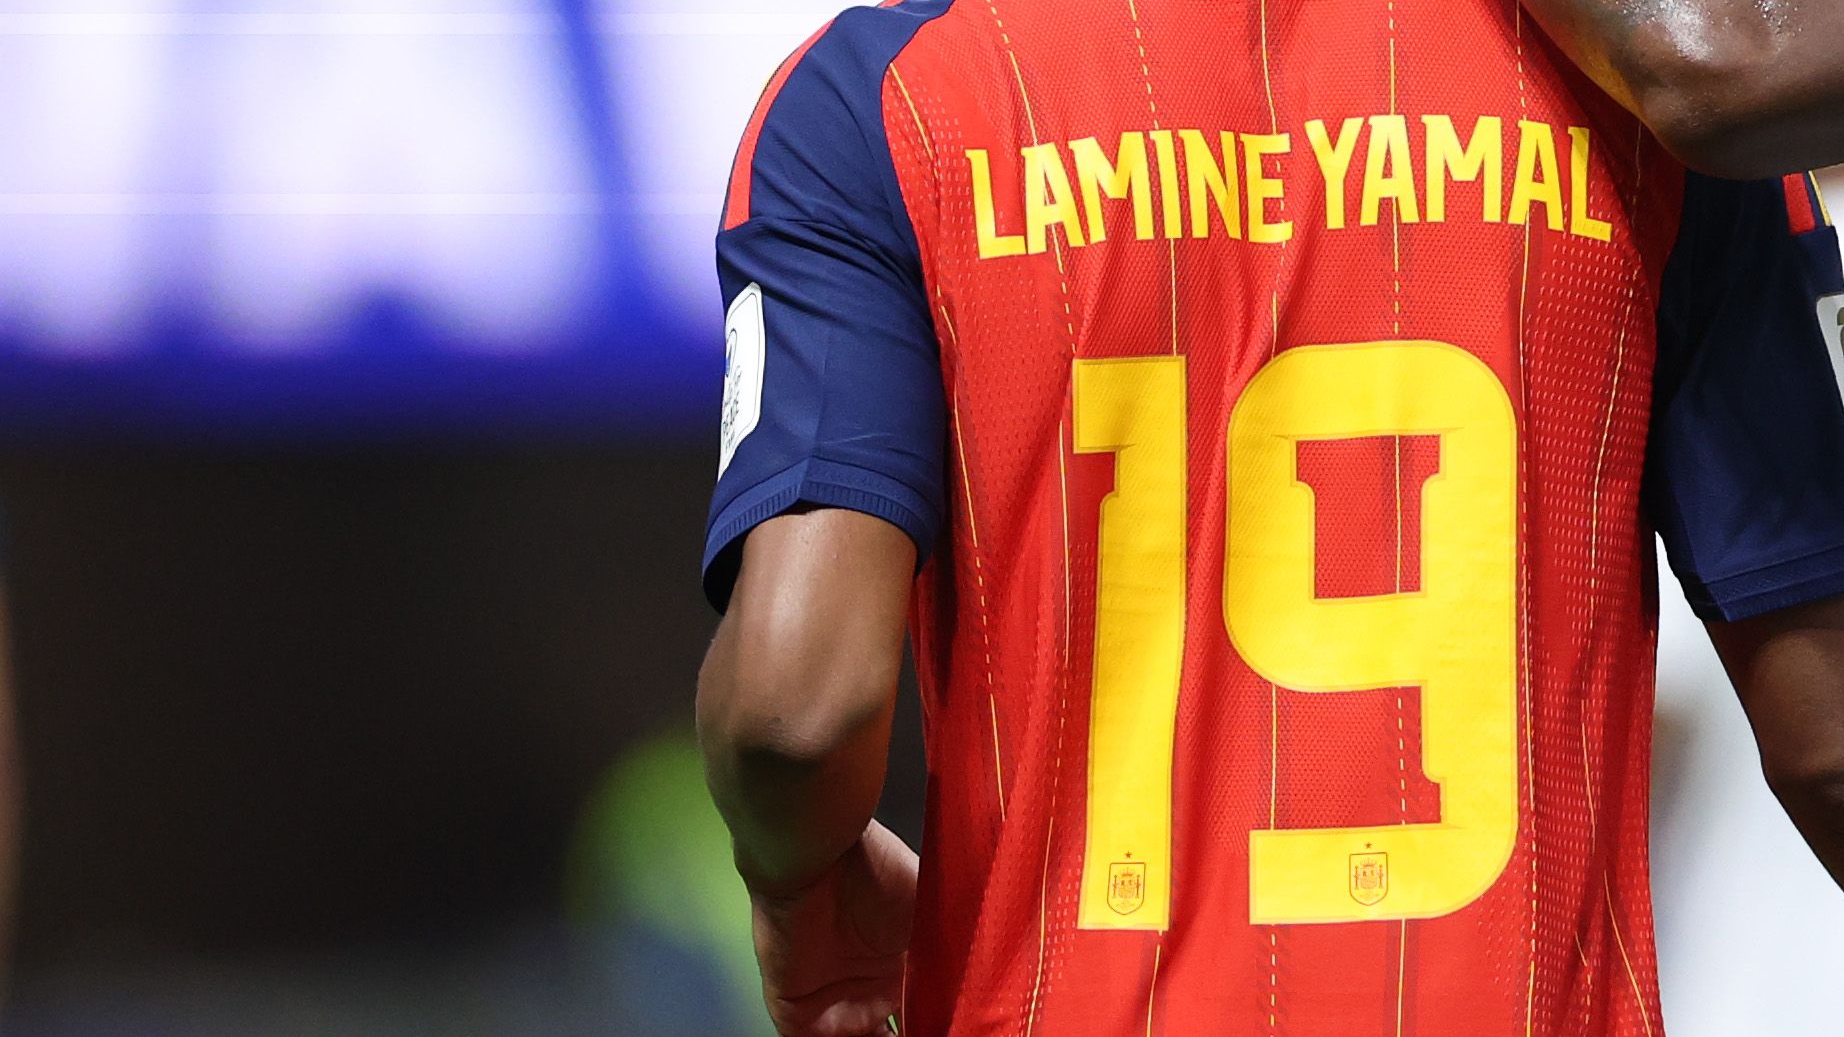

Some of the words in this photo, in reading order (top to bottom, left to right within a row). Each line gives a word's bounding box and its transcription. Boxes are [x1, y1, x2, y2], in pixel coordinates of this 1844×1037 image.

[965, 128, 1294, 260] LAMINE
[1304, 114, 1613, 243] YAMAL
[1072, 340, 1519, 931] 19
